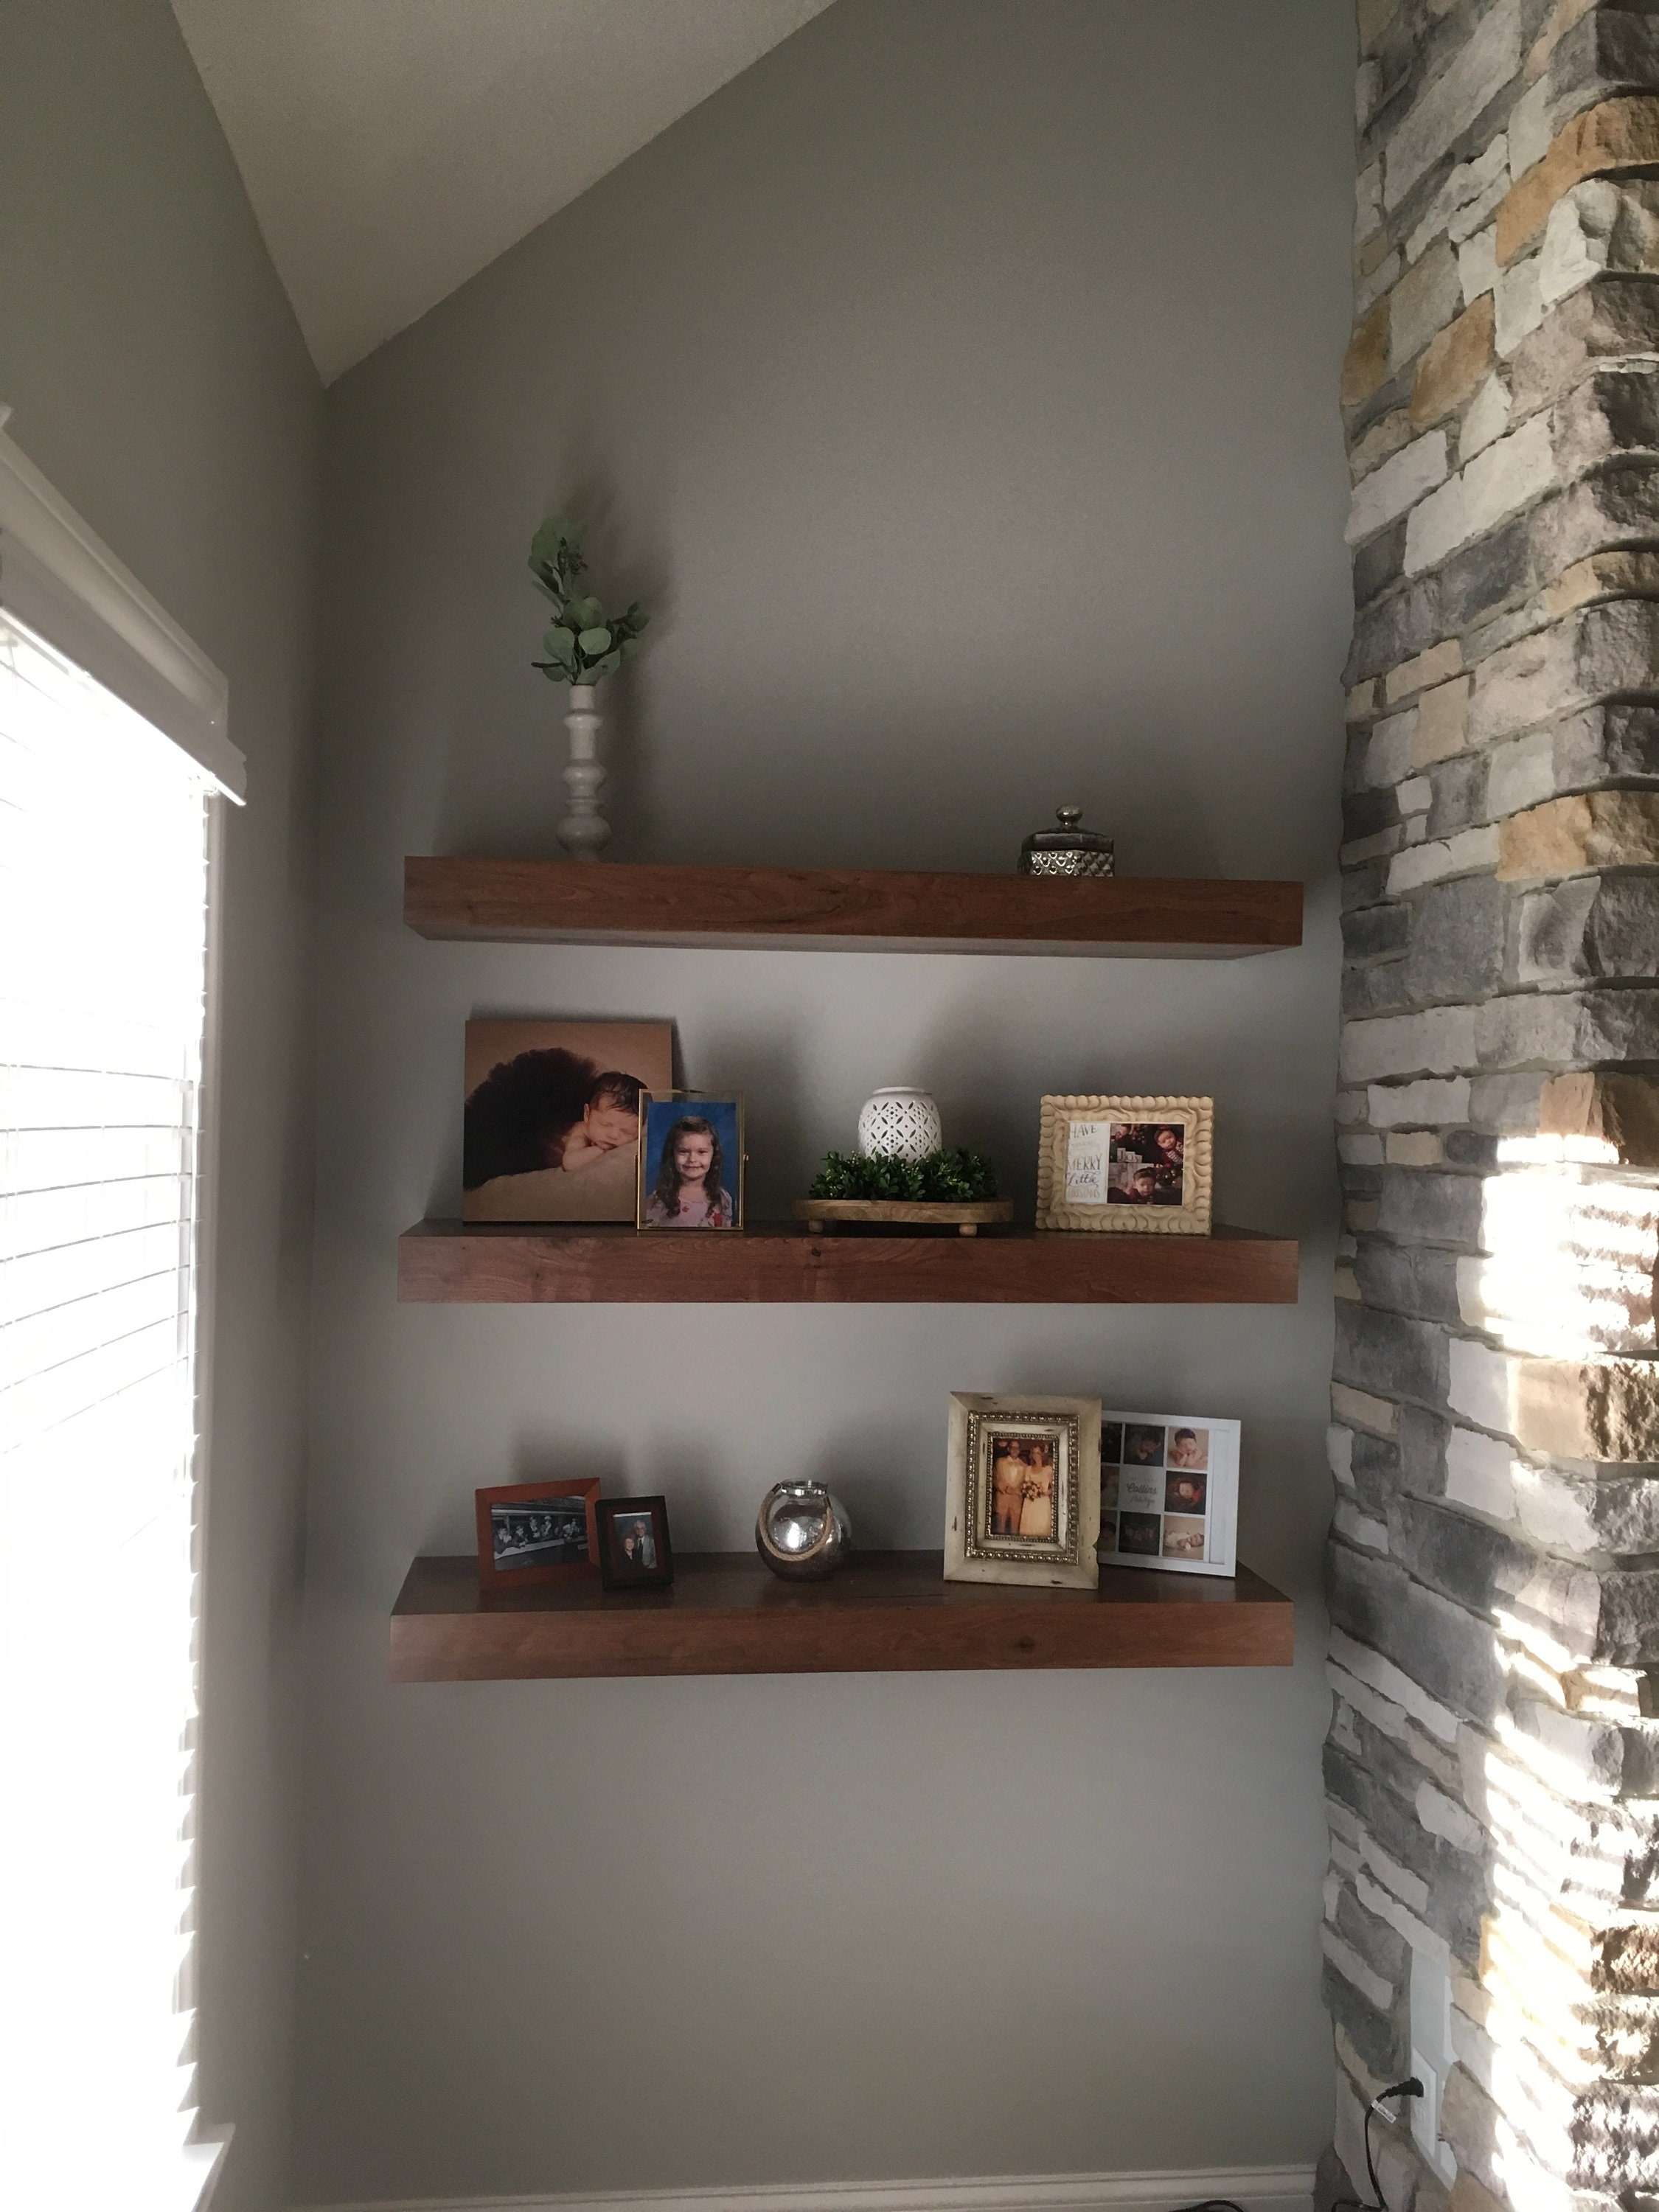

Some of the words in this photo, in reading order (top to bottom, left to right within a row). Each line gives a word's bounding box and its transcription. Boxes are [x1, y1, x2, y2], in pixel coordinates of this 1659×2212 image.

[1069, 1124, 1097, 1138] HAVE
[1068, 1153, 1102, 1170] MERRY
[1067, 1172, 1100, 1188] Little
